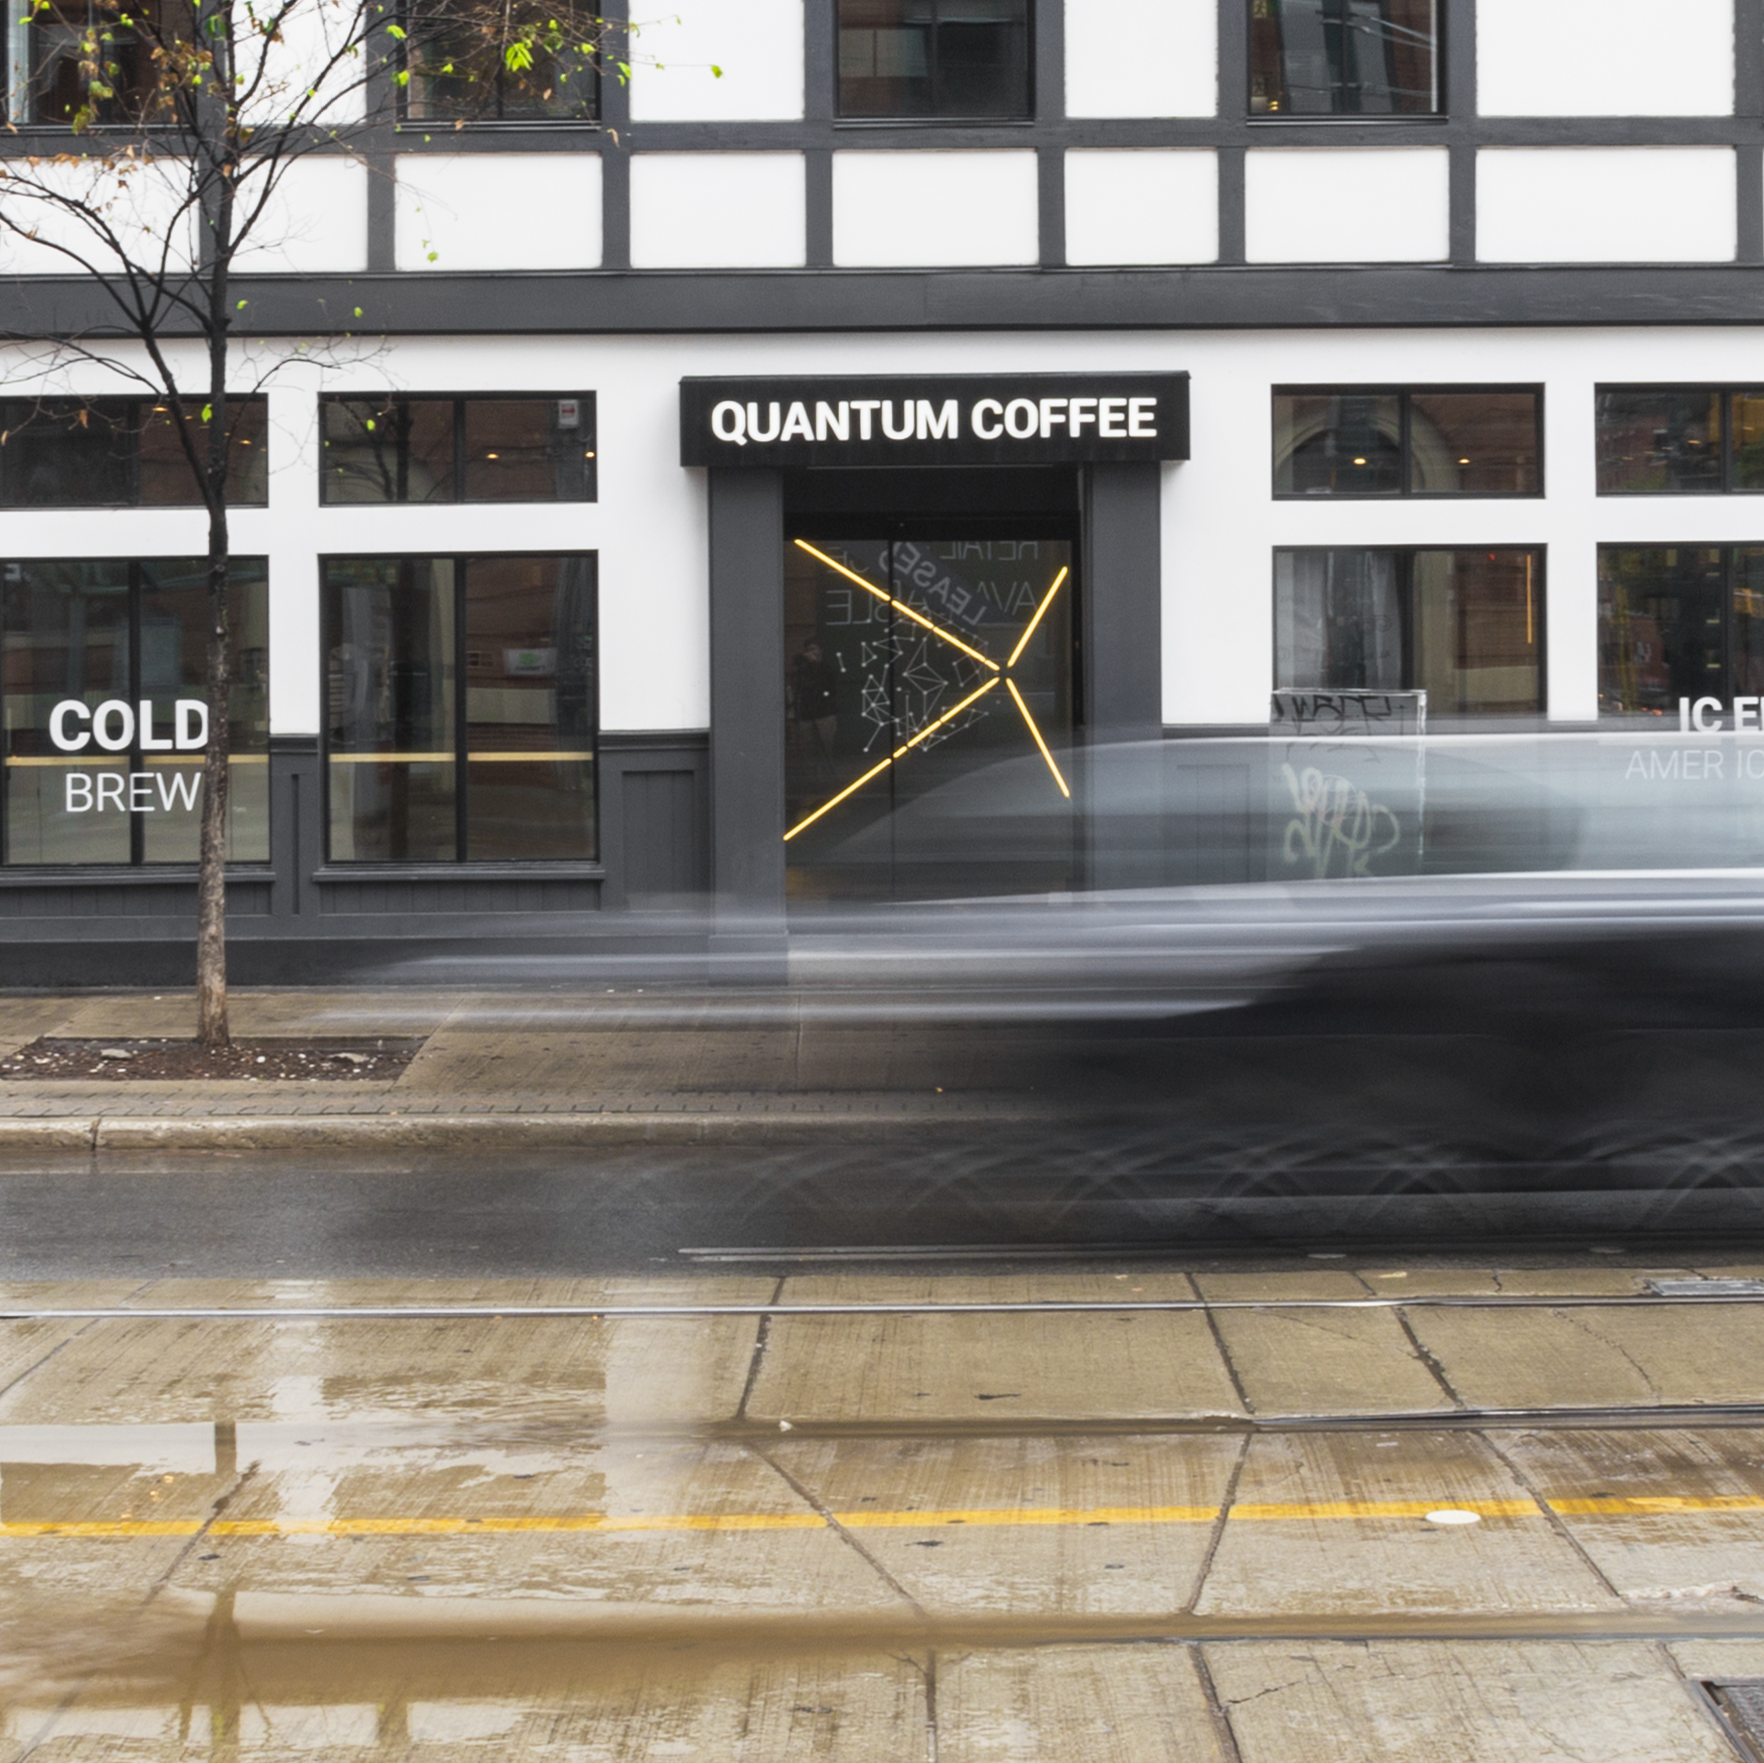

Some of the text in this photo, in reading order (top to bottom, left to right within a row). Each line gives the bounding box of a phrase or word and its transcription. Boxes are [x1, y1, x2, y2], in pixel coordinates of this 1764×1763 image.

[711, 397, 1158, 446] QUANTUM COFFEE
[49, 699, 209, 751] COLD
[65, 771, 202, 813] BREW
